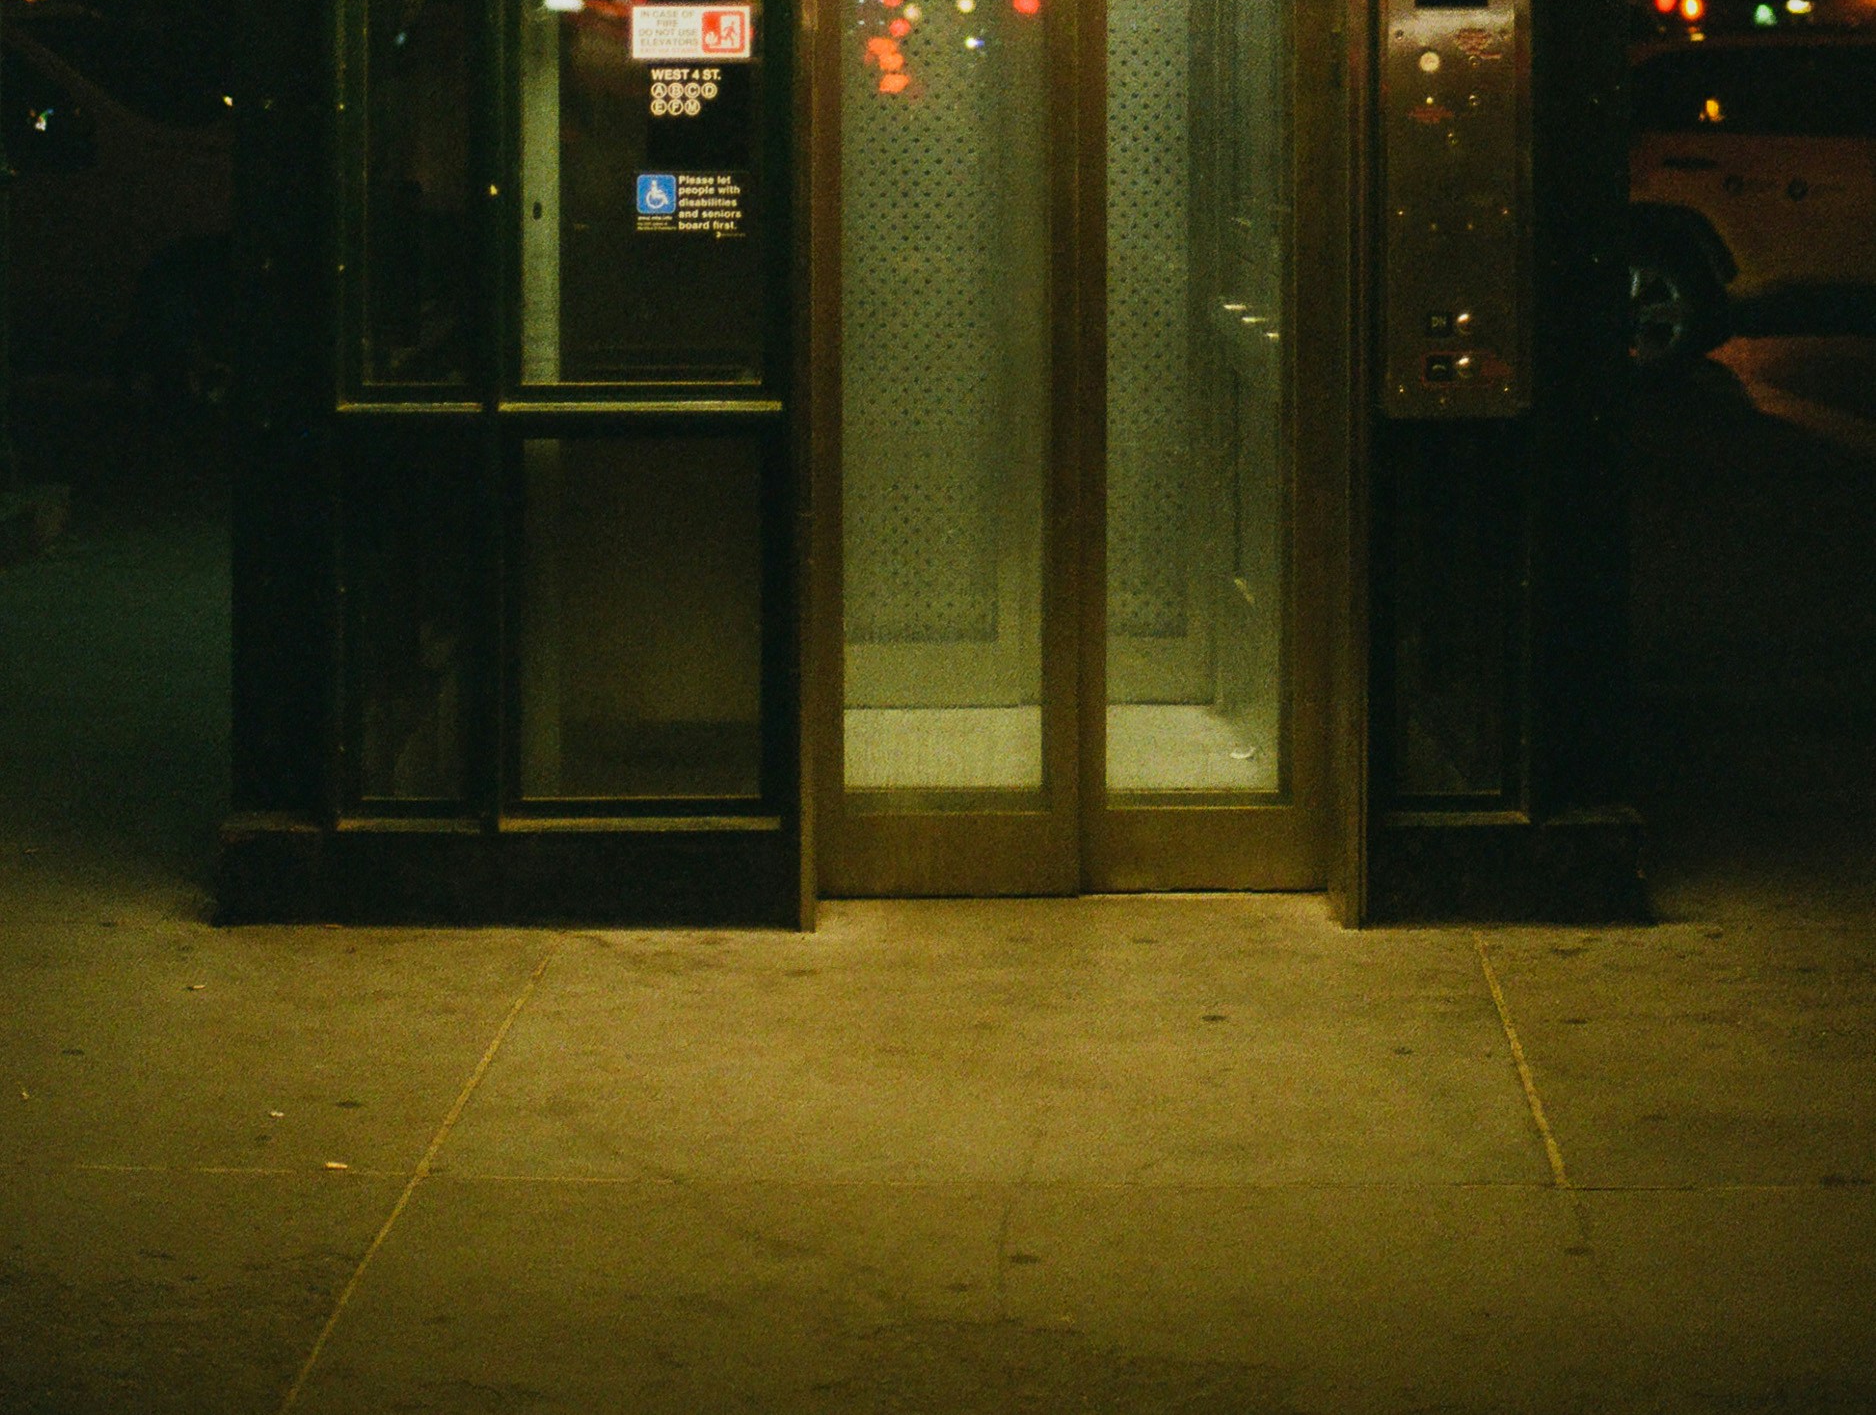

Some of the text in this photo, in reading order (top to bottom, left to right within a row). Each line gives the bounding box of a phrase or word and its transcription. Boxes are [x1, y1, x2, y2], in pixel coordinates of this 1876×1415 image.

[640, 10, 694, 18] IN CASE OF
[657, 19, 679, 27] FIRE
[638, 29, 698, 37] DO NOT USE
[640, 38, 699, 47] ELEVATORS
[651, 69, 722, 80] WEST 4 ST.
[678, 175, 732, 185] Please let
[678, 185, 741, 196] people with
[678, 198, 738, 207] disabilities
[678, 209, 699, 219] and
[702, 209, 742, 219] seniors
[678, 221, 710, 230] board
[712, 221, 738, 230] first.
